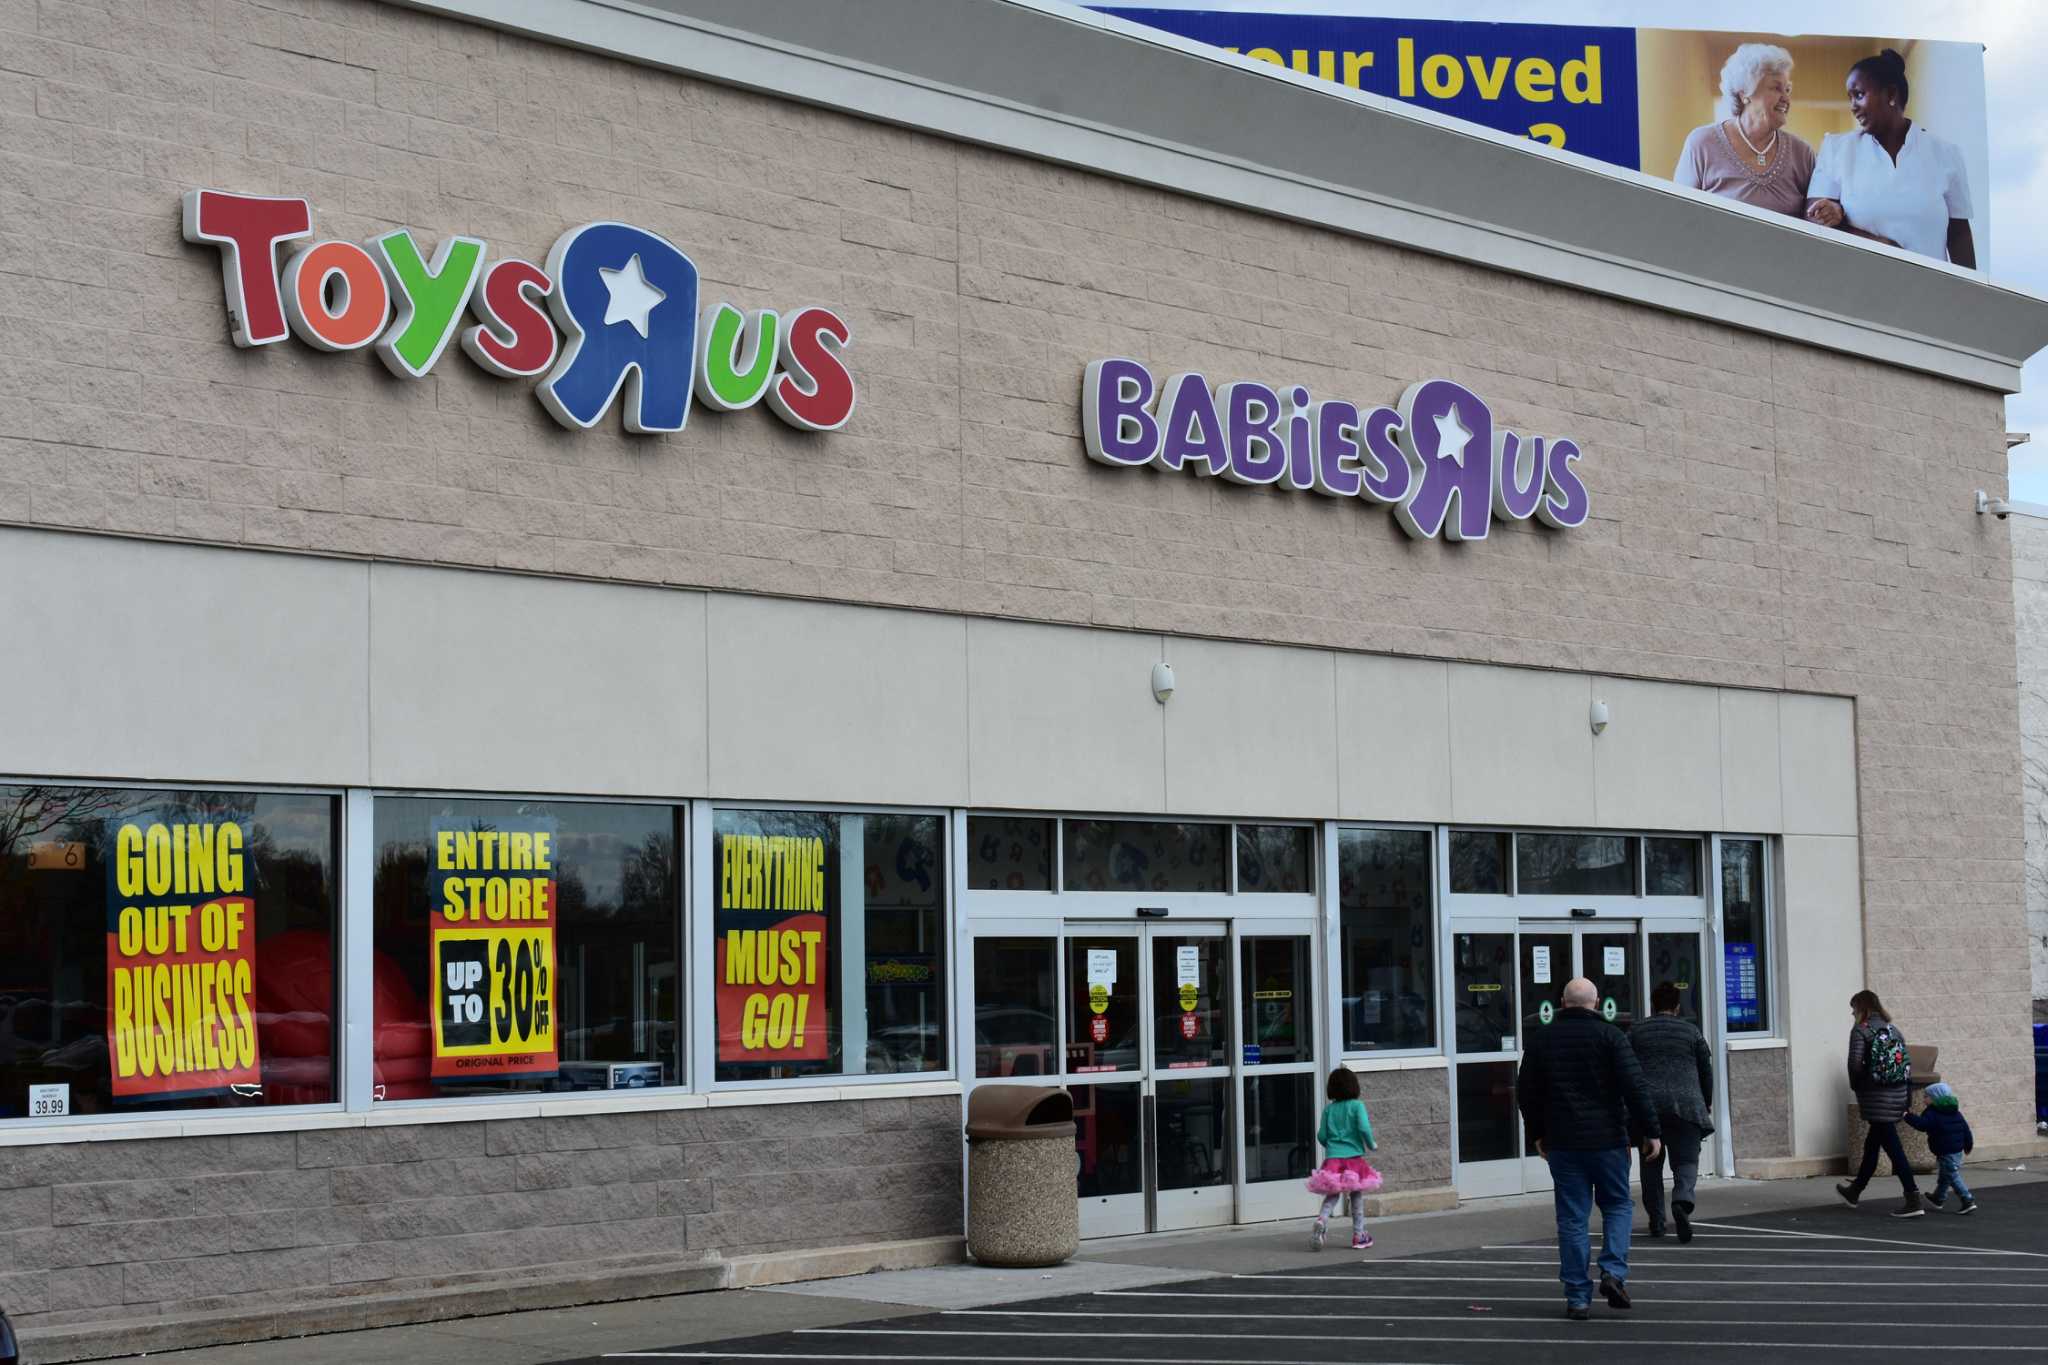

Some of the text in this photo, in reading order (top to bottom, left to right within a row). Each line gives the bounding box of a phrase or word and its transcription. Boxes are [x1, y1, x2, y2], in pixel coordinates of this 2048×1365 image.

[1397, 37, 1602, 104] loved
[700, 301, 856, 433] US
[1493, 429, 1590, 529] US
[116, 821, 244, 897] GOING
[437, 831, 551, 870] ENTIRE
[721, 833, 825, 913] EVERYTHING
[442, 876, 549, 921] STORE
[118, 903, 245, 957] OUT OF
[725, 929, 822, 986] MUST
[446, 960, 483, 991] UP
[113, 958, 256, 1077] BUSINESS
[448, 994, 484, 1024] TO
[534, 1000, 550, 1036] OFF
[740, 992, 810, 1050] GO!
[455, 1055, 535, 1069] ORIGINAL PRICE
[35, 1099, 64, 1114] 39.99
